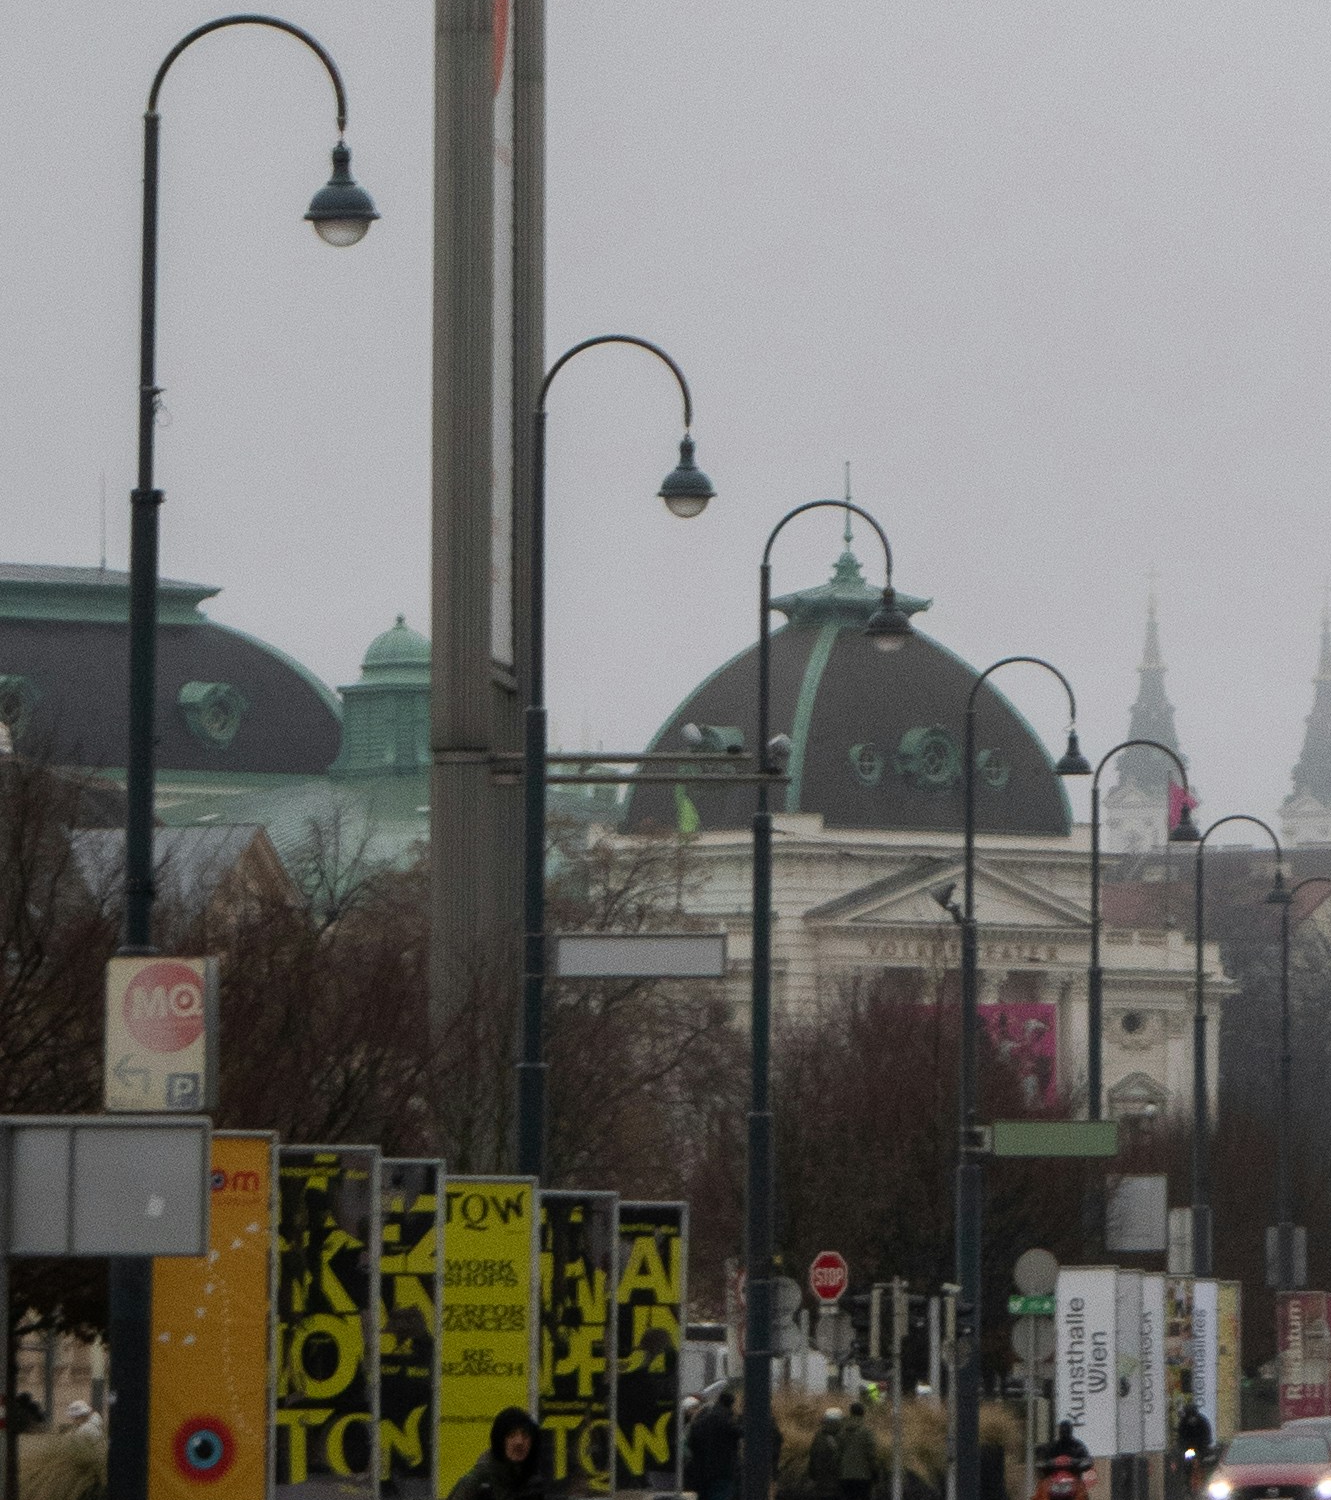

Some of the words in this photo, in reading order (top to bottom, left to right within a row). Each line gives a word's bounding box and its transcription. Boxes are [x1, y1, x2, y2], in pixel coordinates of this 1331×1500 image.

[131, 983, 204, 1019] MQ
[173, 1078, 195, 1105] P
[445, 1190, 526, 1231] TQW
[445, 1260, 514, 1272] WORK
[814, 1266, 845, 1287] STOP
[1065, 1297, 1086, 1428] Kunsthalle
[1087, 1330, 1108, 1395] Wien
